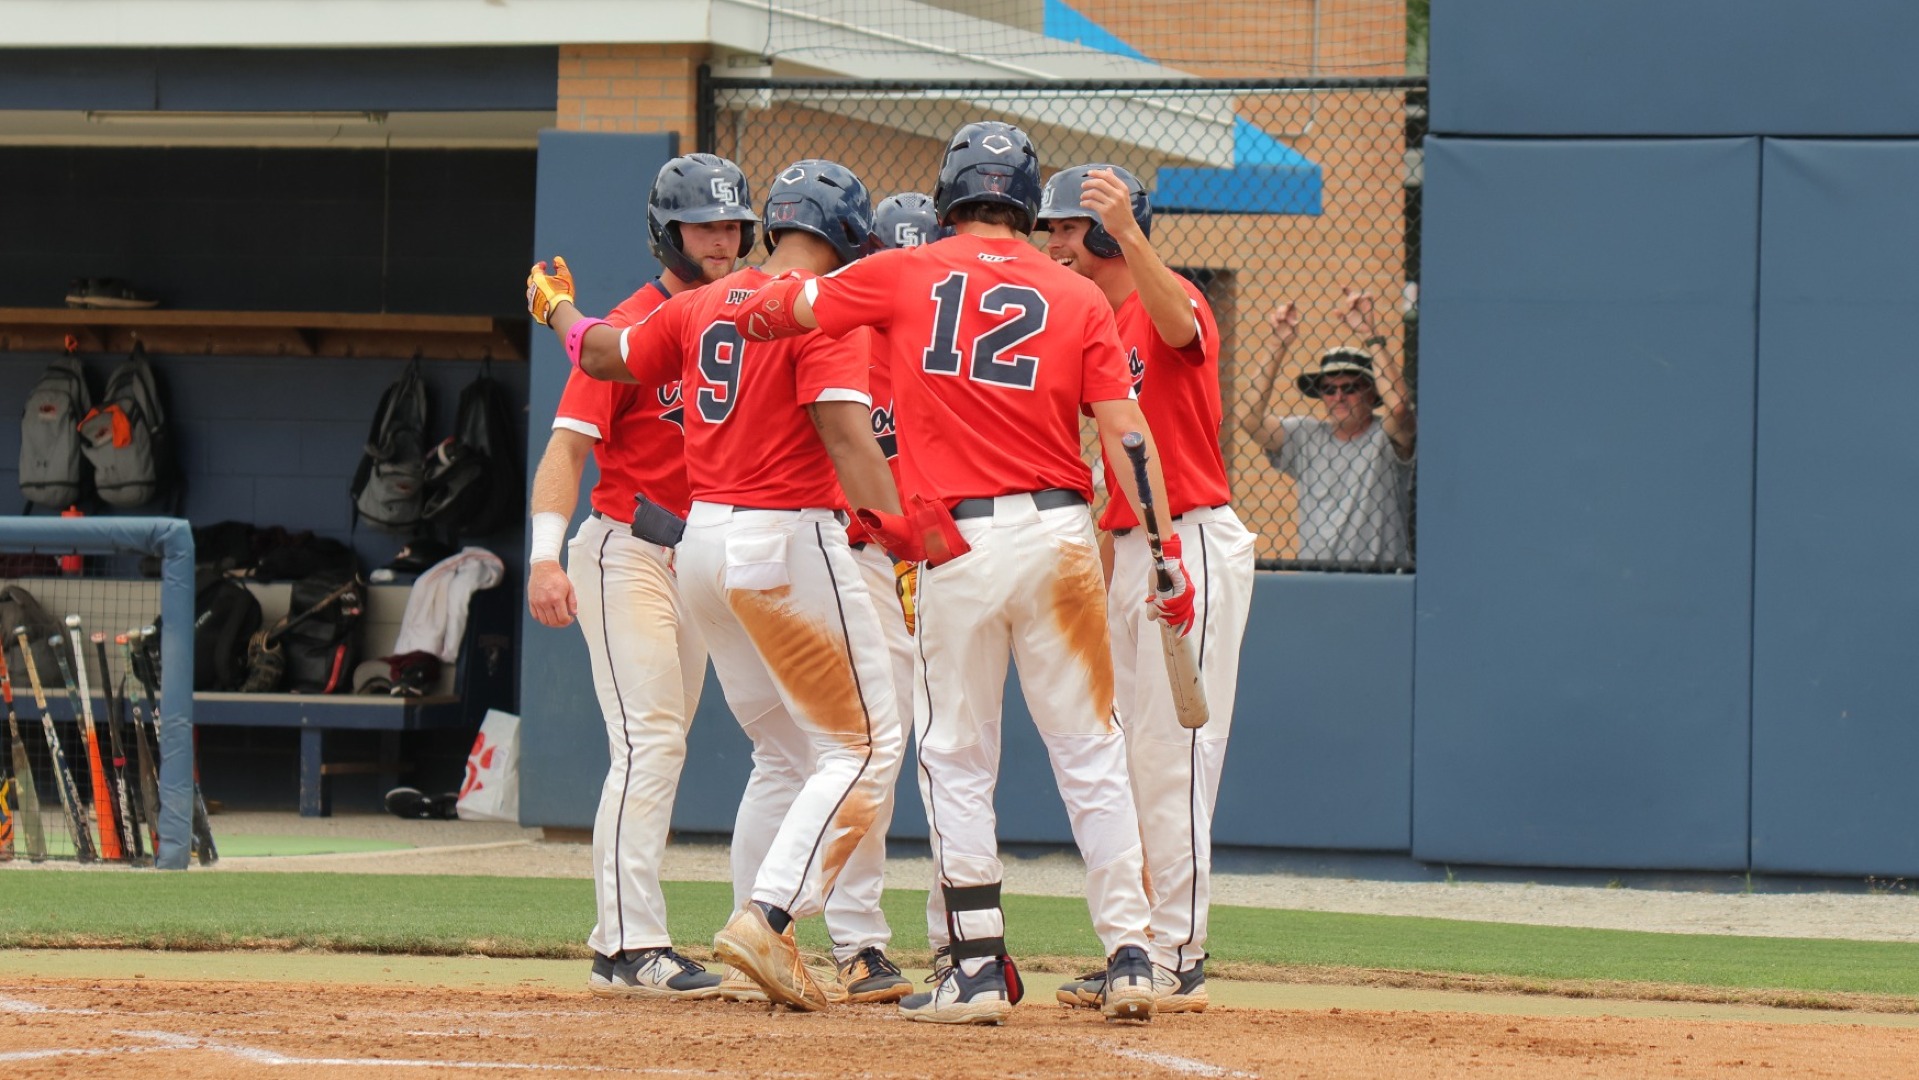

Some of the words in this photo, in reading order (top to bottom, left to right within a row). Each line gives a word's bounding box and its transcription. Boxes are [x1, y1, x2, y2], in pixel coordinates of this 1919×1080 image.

[711, 177, 739, 206] CSU
[696, 320, 746, 424] 9
[923, 271, 1049, 391] 12
